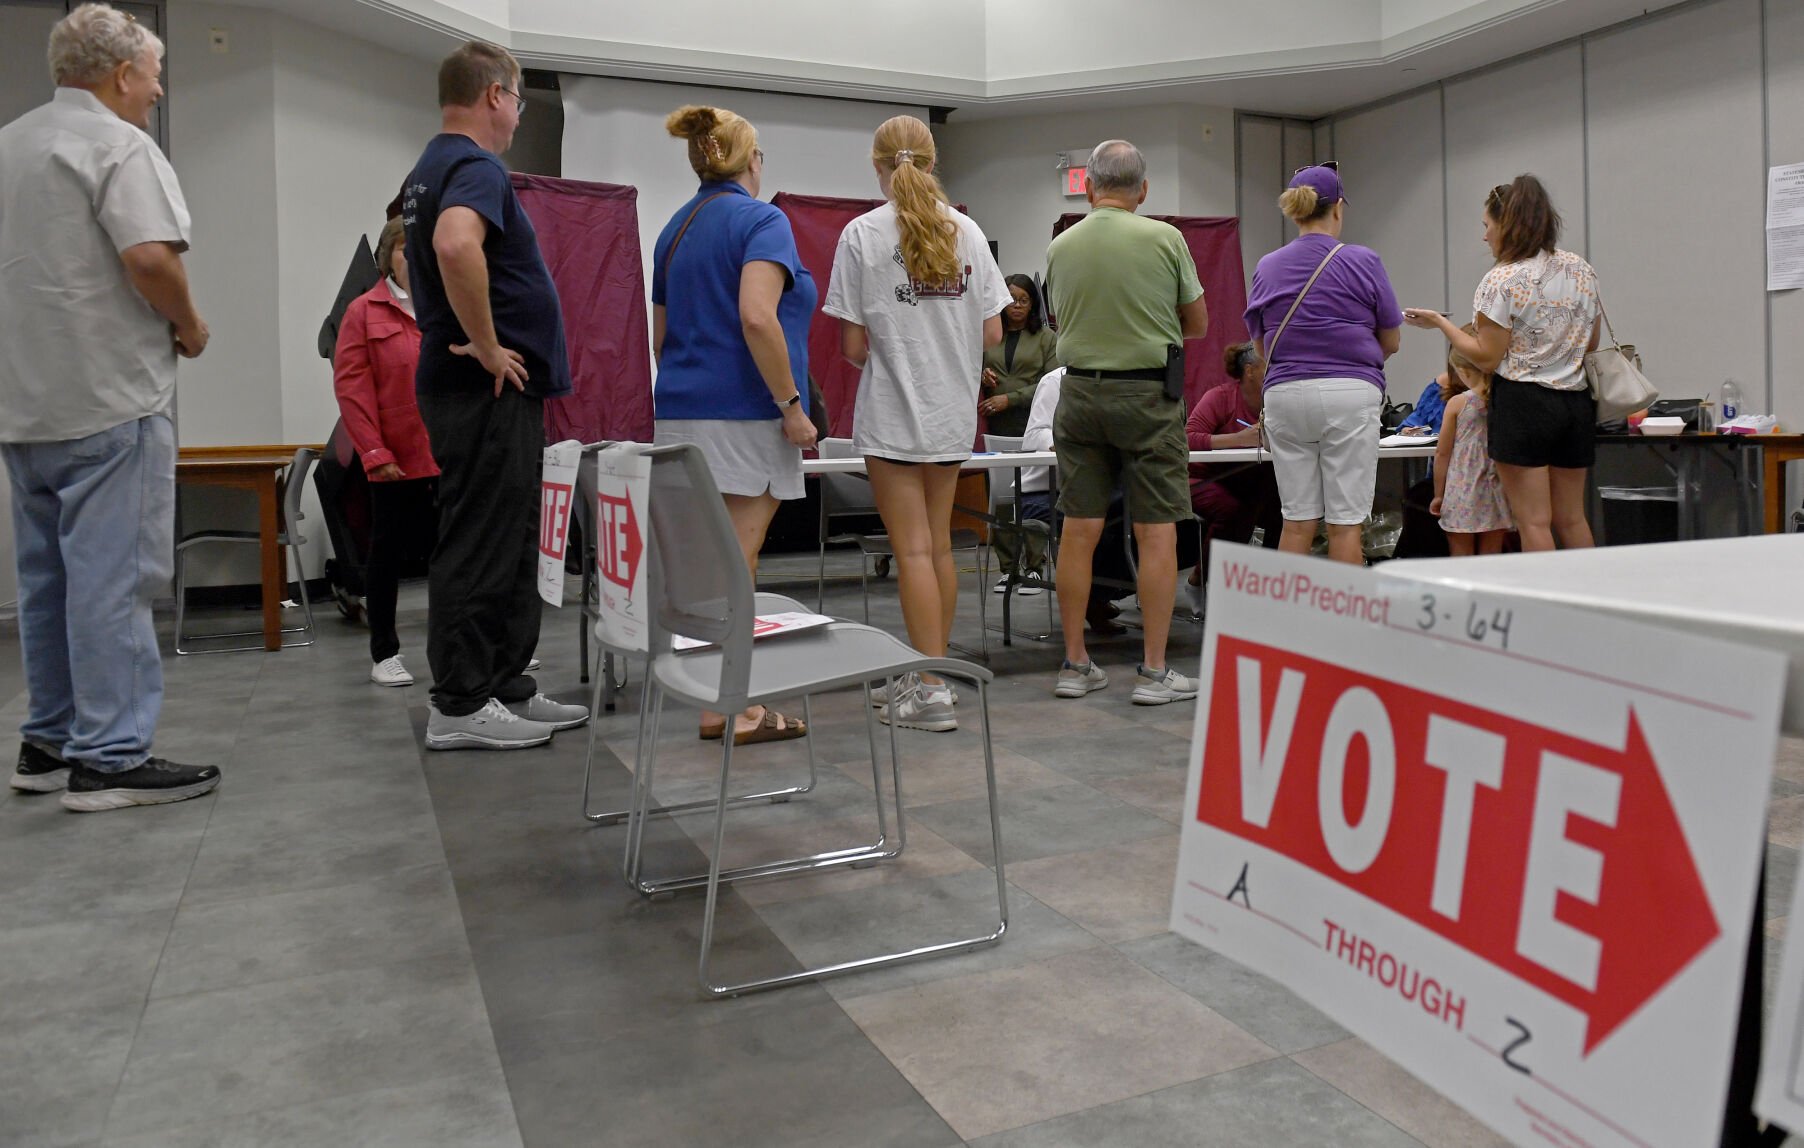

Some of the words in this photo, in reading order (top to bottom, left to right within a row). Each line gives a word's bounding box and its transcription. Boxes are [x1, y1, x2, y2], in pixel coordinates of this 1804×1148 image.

[1222, 560, 1390, 626] Ward/Precinct
[1236, 655, 1623, 993] VOTE
[1226, 861, 1252, 911] A
[1323, 918, 1467, 1032] THROUGH
